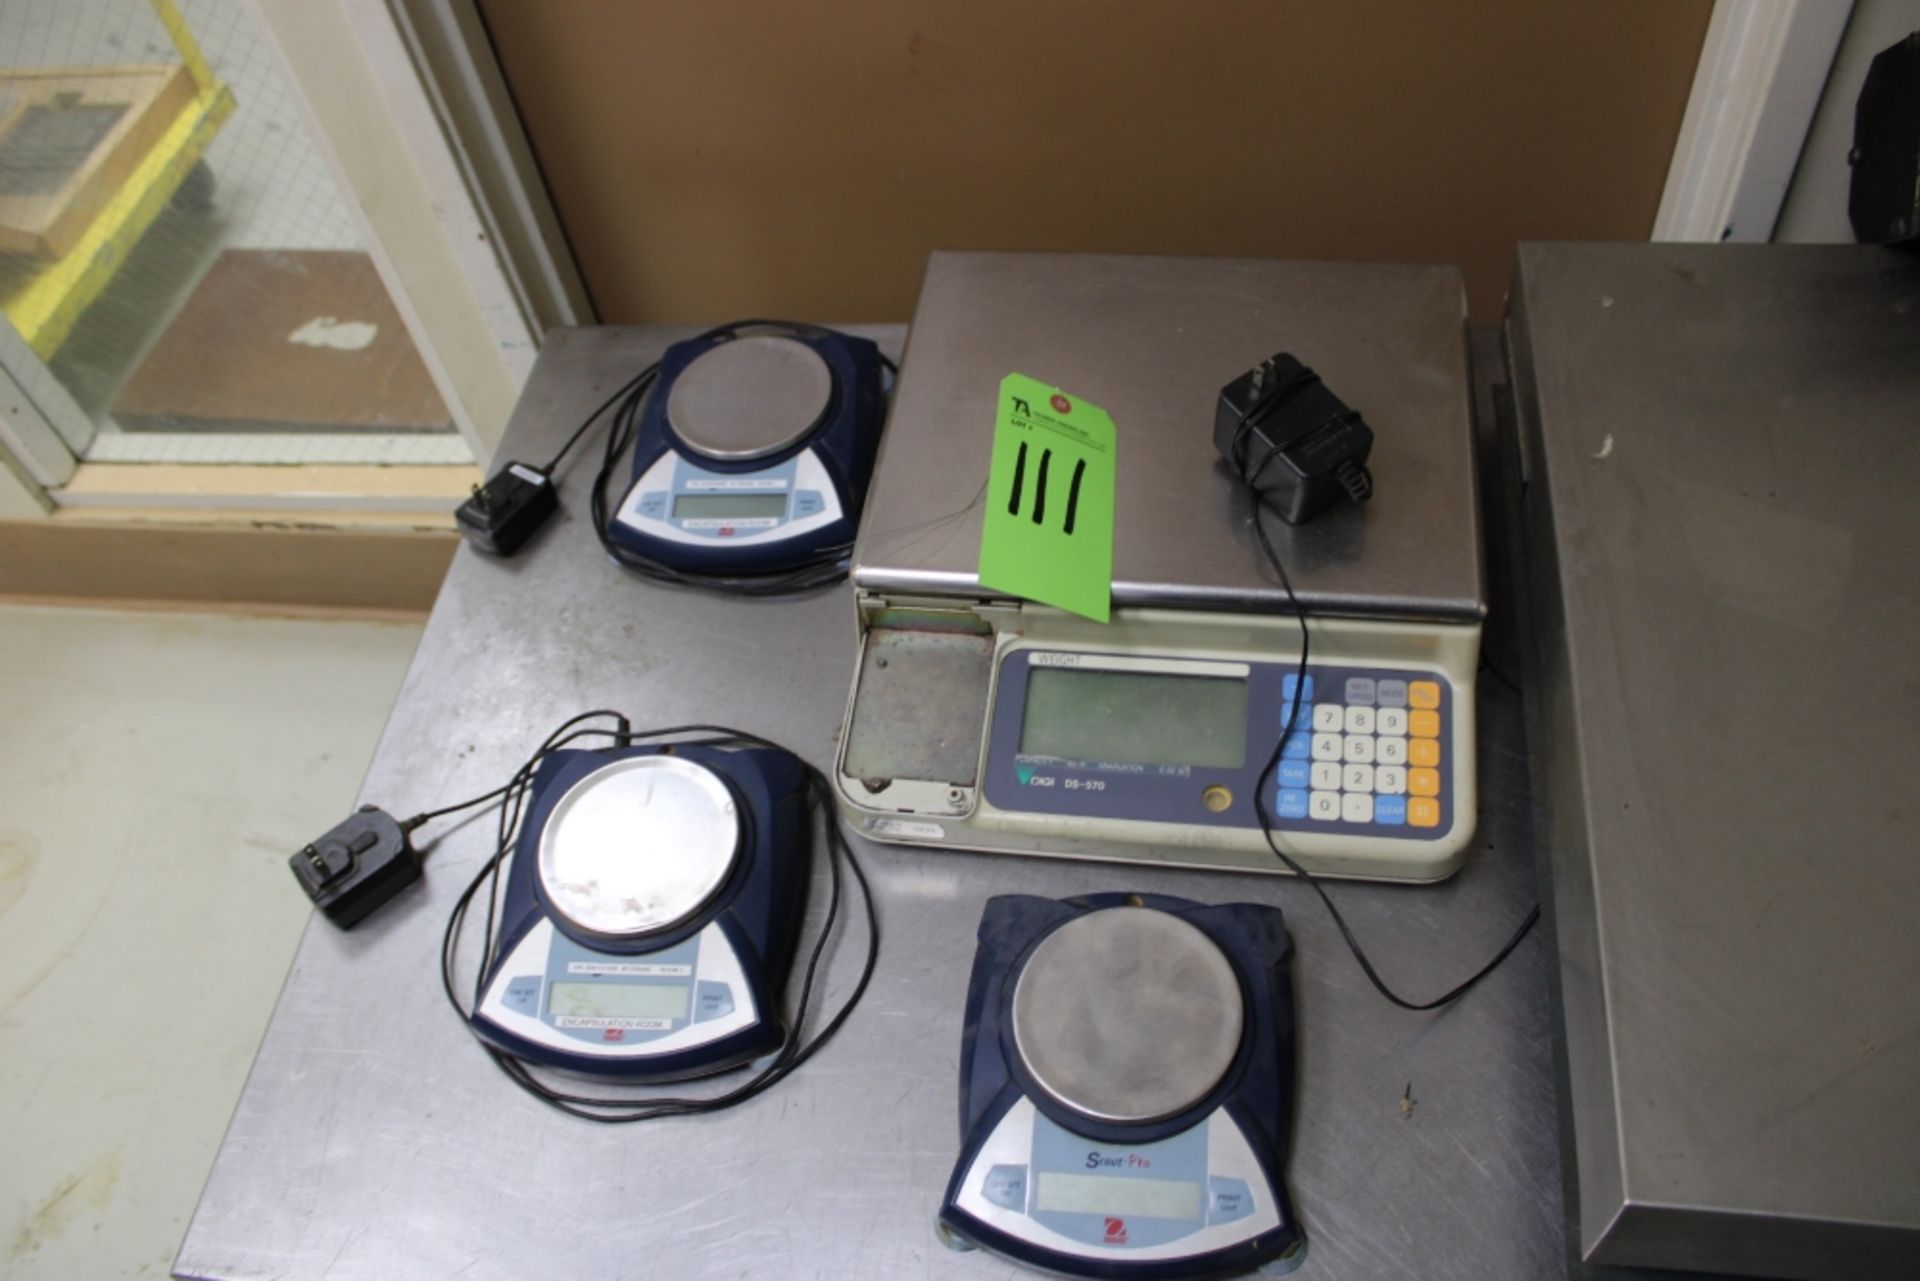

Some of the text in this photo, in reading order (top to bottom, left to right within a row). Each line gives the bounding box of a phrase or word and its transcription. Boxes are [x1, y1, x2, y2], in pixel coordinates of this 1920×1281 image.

[1039, 654, 1081, 665] WEIGHT
[1324, 712, 1334, 724] 7
[1355, 714, 1365, 726] 8
[1387, 715, 1397, 727] 9
[1322, 741, 1331, 752] 4
[1354, 743, 1364, 754] 5
[1386, 744, 1396, 756] 6
[1323, 769, 1329, 781] 1
[1354, 772, 1363, 784] 2
[1386, 774, 1395, 786] 3
[1064, 778, 1105, 791] DS-570
[1320, 799, 1330, 811] 0
[1377, 803, 1404, 814] CLEAR
[561, 1017, 663, 1029] ENCAPSULATION ROOM
[1086, 1151, 1151, 1169] Scout Pro
